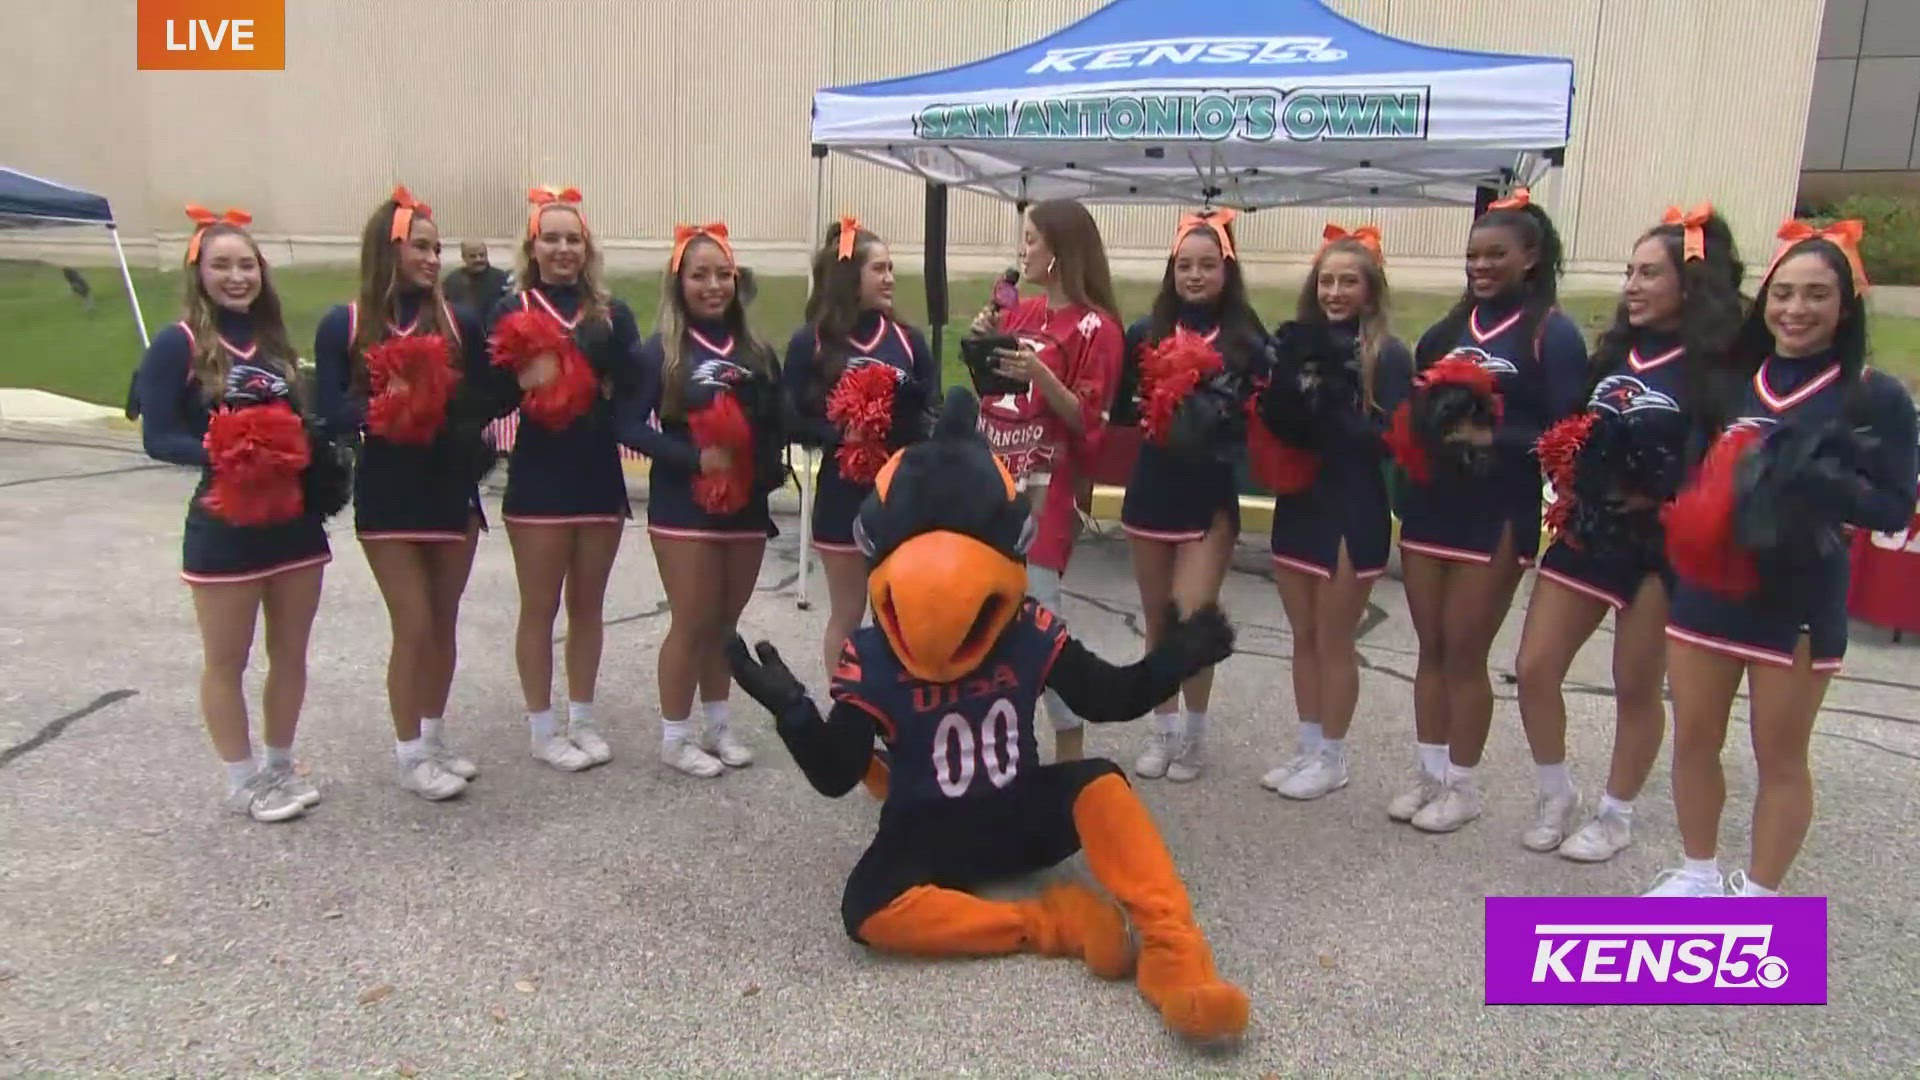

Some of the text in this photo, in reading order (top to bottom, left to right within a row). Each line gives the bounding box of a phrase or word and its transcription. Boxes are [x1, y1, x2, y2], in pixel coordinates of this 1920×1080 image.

[921, 94, 1420, 140] SAN ANTONIO'S OWN
[932, 697, 1020, 798] 00
